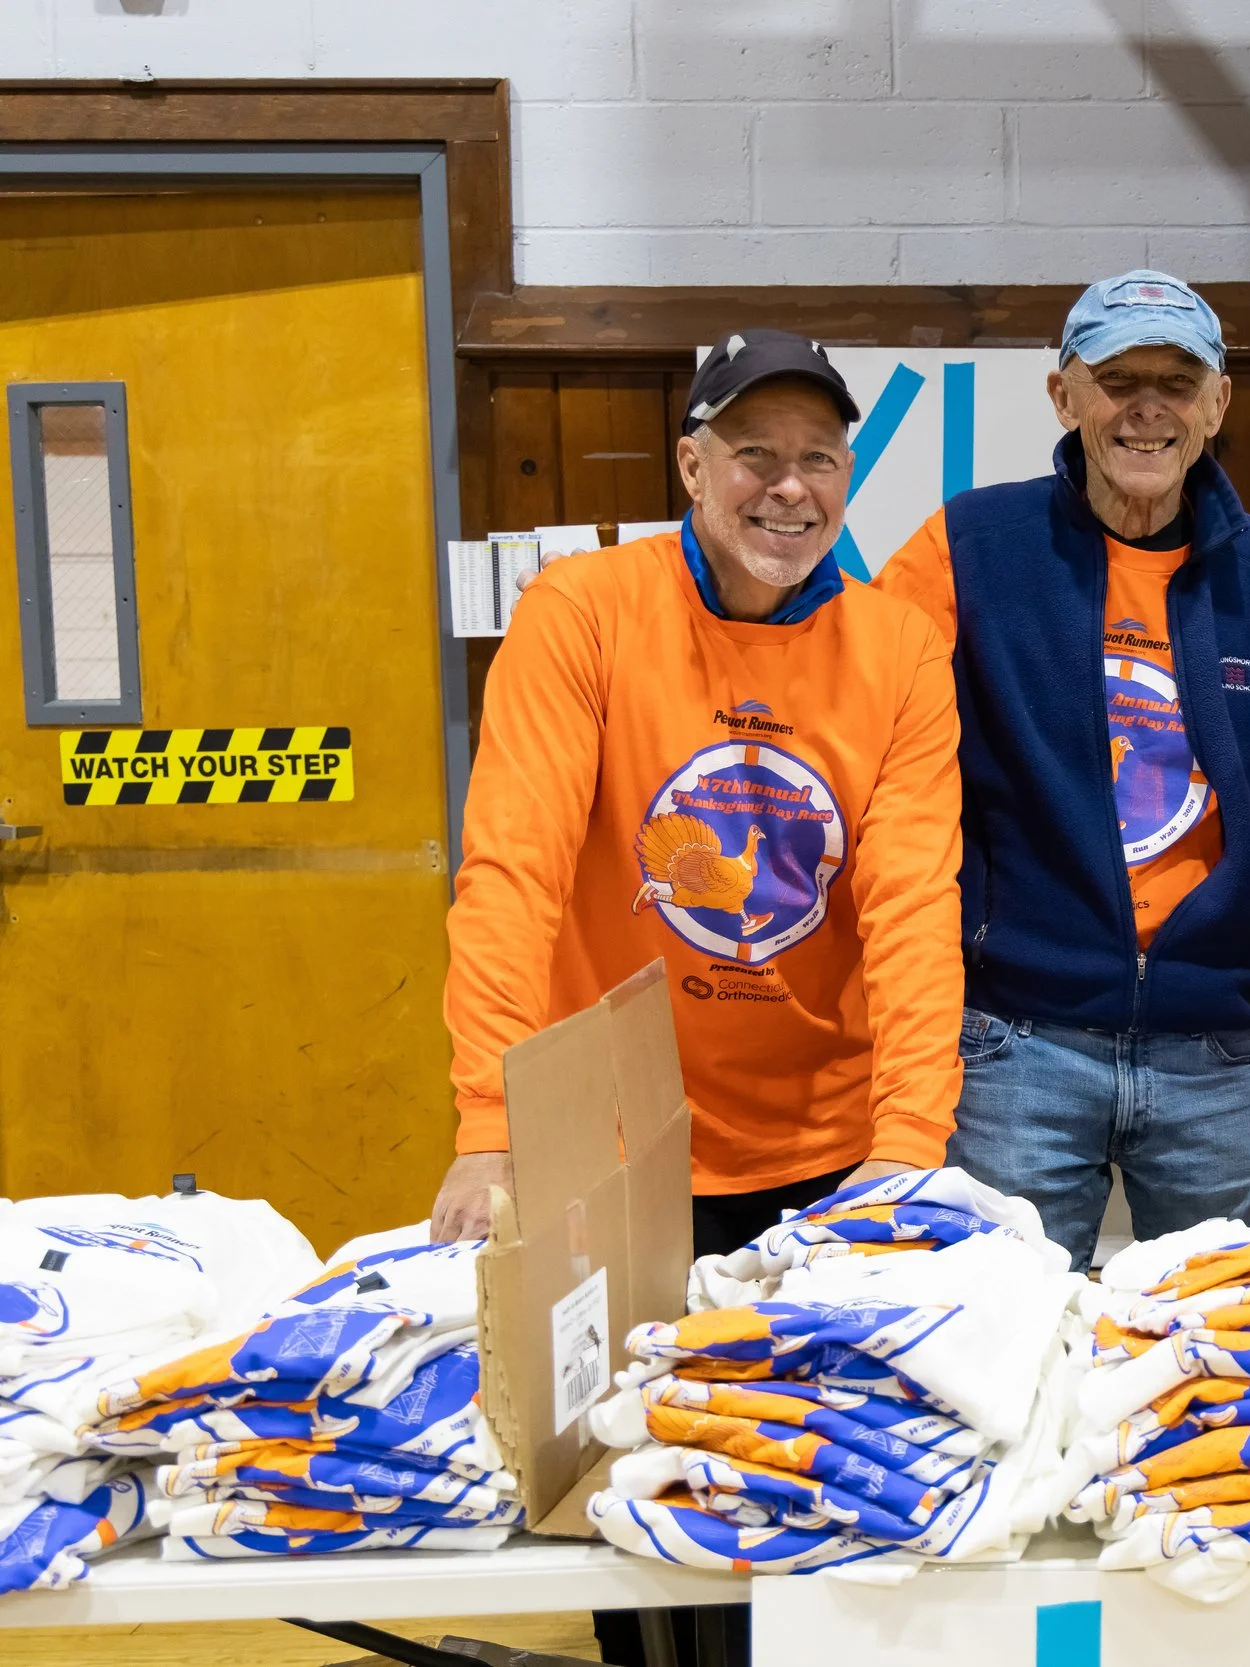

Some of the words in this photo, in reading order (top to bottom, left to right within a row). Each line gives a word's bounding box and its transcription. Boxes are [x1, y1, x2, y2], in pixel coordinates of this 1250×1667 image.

[1125, 634, 1171, 651] Runners
[1110, 692, 1180, 715] Annual
[748, 716, 794, 736] Runners
[1137, 715, 1165, 732] Day
[1166, 720, 1185, 733] Ra
[70, 756, 170, 780] WATCH
[179, 755, 259, 778] YOUR
[267, 753, 341, 776] STEP
[698, 775, 741, 795] 47th
[766, 804, 795, 822] Day
[796, 809, 834, 822] Race
[1132, 844, 1149, 854] Run
[1159, 825, 1178, 842] Walk
[709, 963, 765, 977] Presented
[765, 967, 776, 976] by
[883, 1176, 908, 1196] Walk
